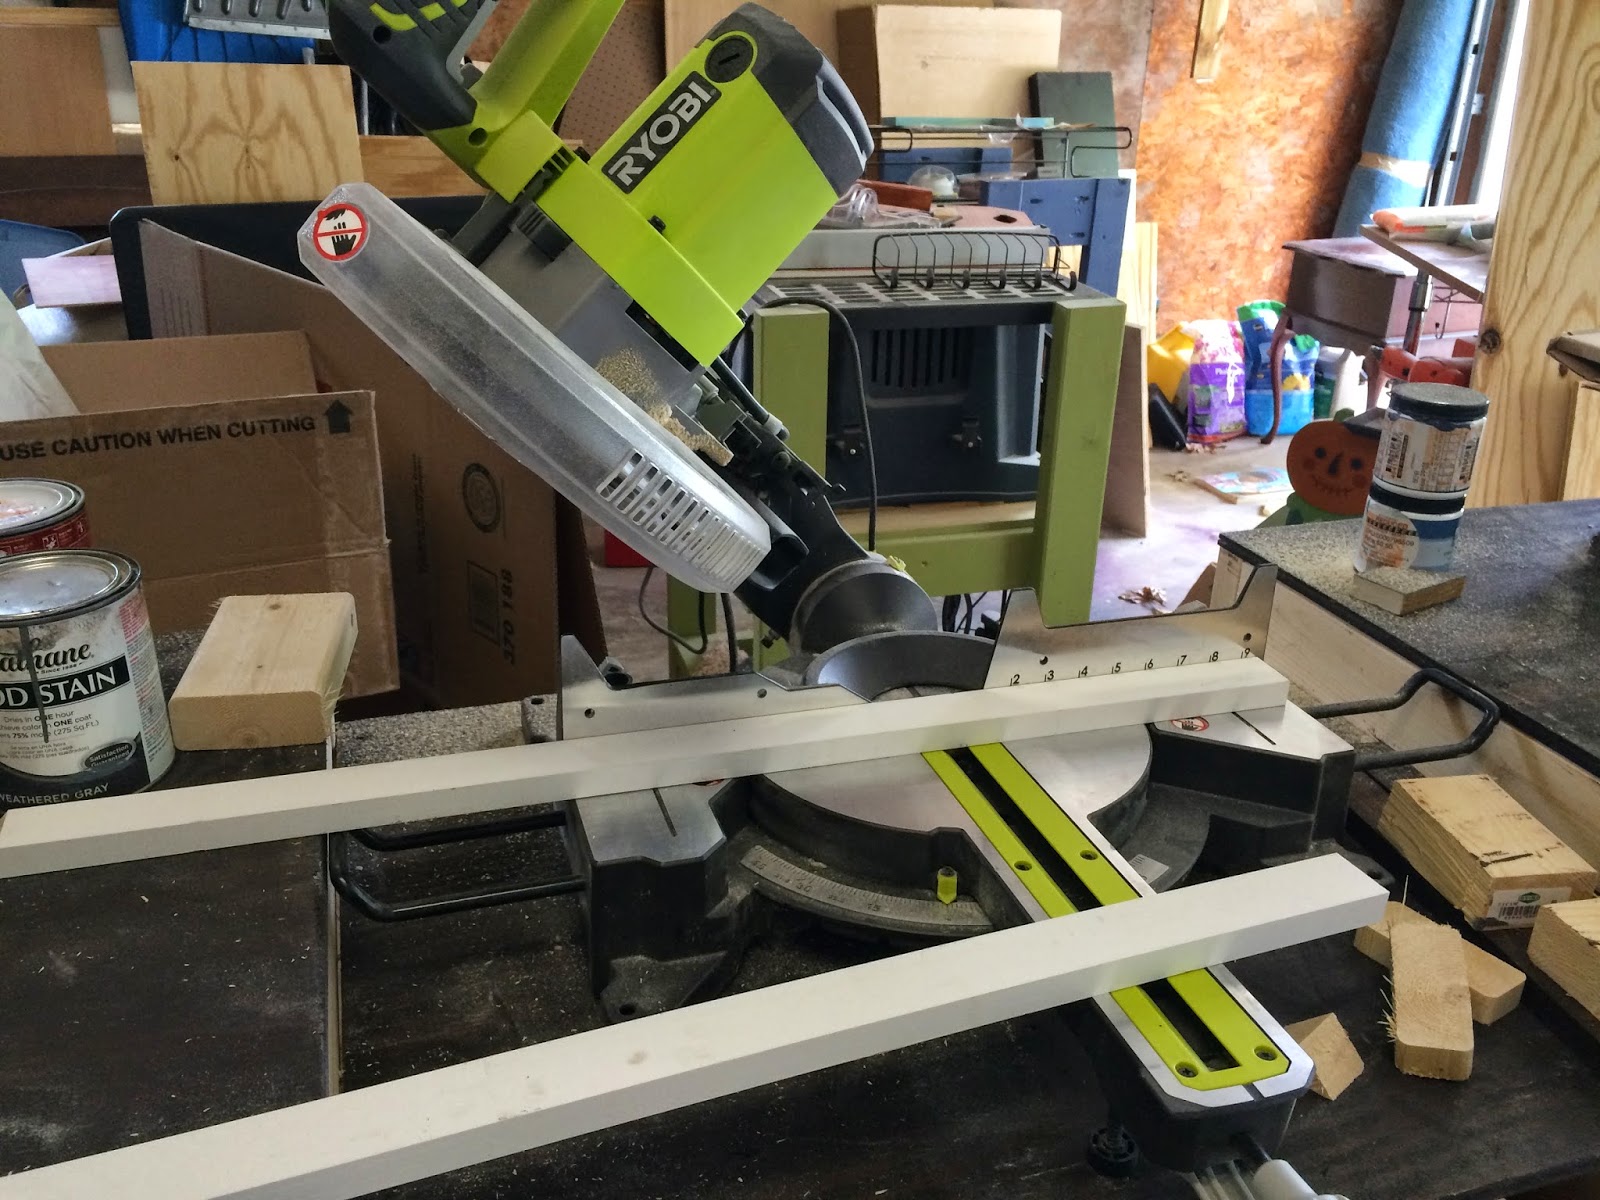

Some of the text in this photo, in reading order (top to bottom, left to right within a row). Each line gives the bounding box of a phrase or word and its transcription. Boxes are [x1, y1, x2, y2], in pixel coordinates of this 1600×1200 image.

[608, 81, 713, 186] RYOBI
[0, 416, 316, 461] USE CAUTION WHEN CUTTING
[39, 666, 116, 704] STAIN
[54, 718, 73, 727] ONE
[75, 713, 92, 723] coat
[55, 710, 74, 719] hour
[53, 726, 72, 736] (275
[89, 744, 129, 762] Satisfaction
[75, 783, 109, 799] GRAY
